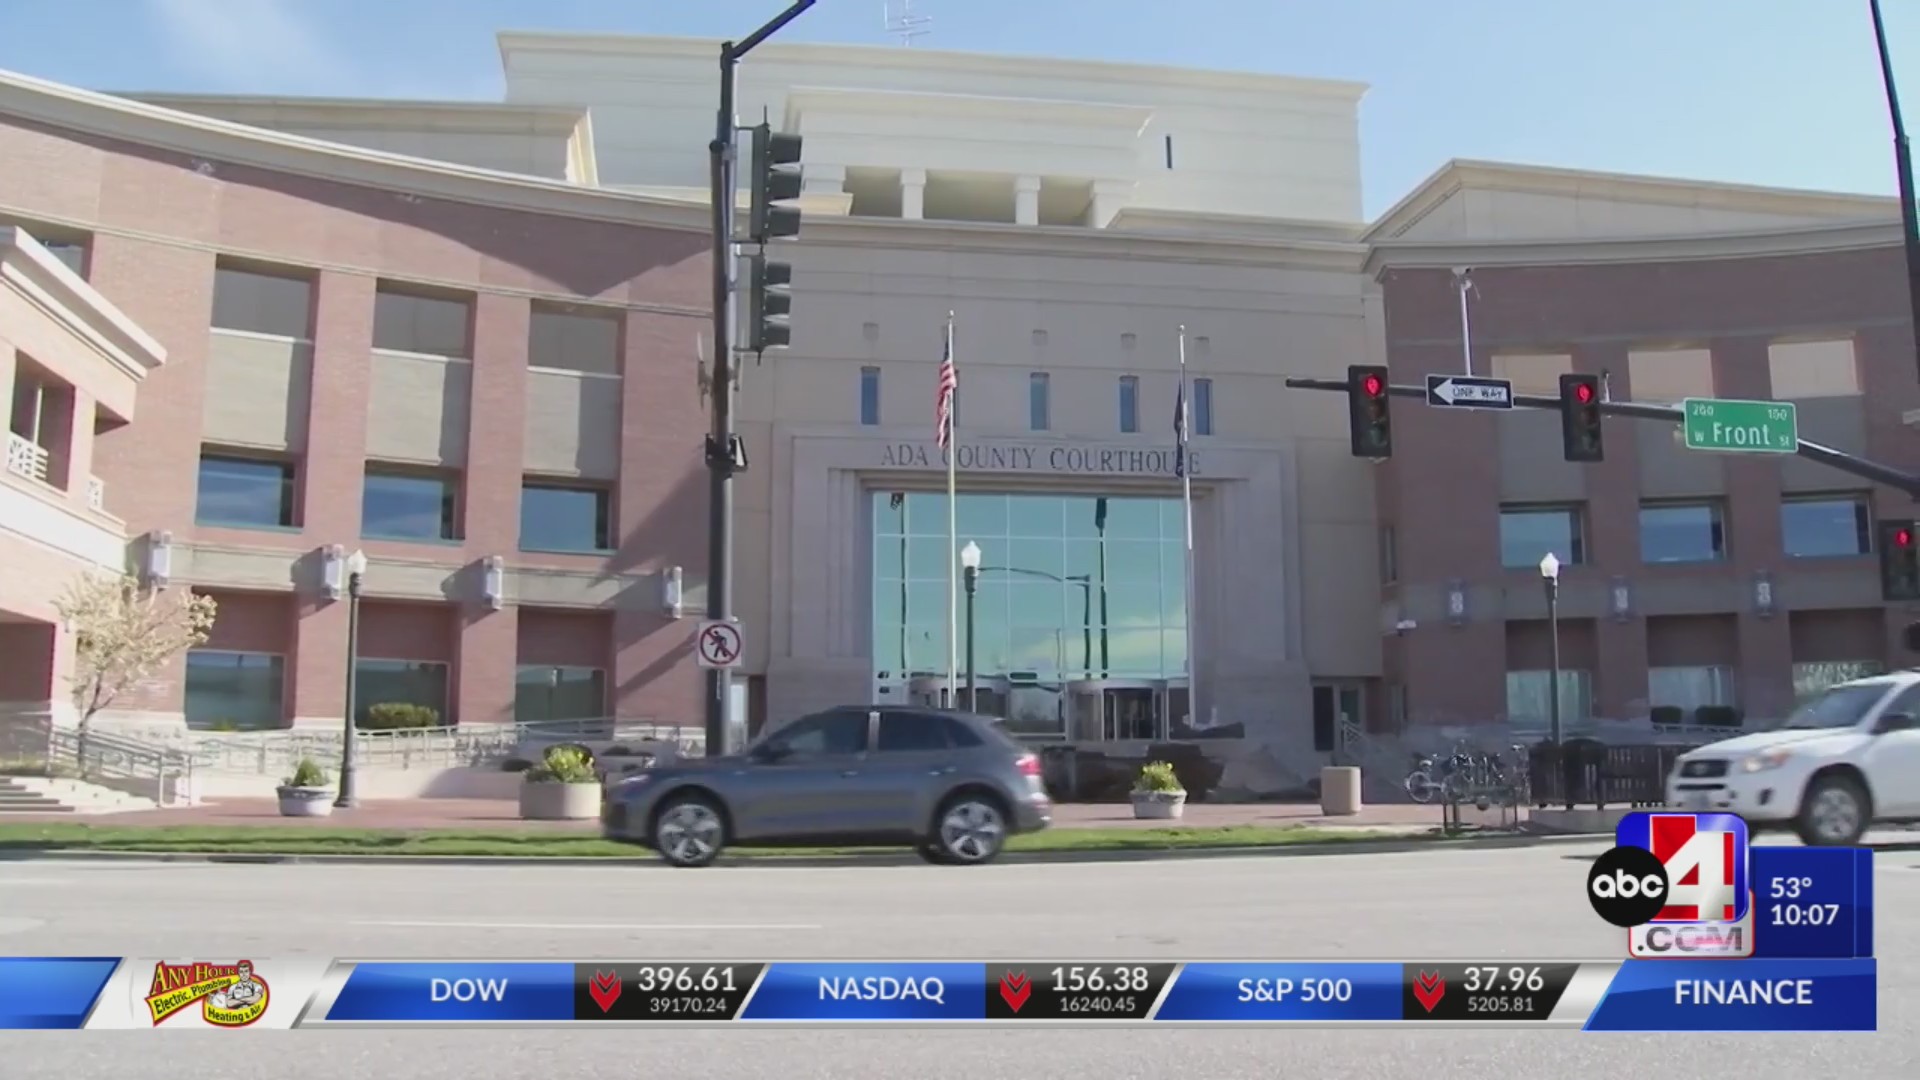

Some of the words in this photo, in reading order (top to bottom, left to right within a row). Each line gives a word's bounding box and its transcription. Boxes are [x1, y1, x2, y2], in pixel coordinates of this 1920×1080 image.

[1480, 388, 1503, 398] WAY
[1694, 431, 1705, 442] W
[1713, 421, 1771, 445] Front
[881, 443, 929, 466] ADA
[1050, 447, 1202, 475] COURTHOUE
